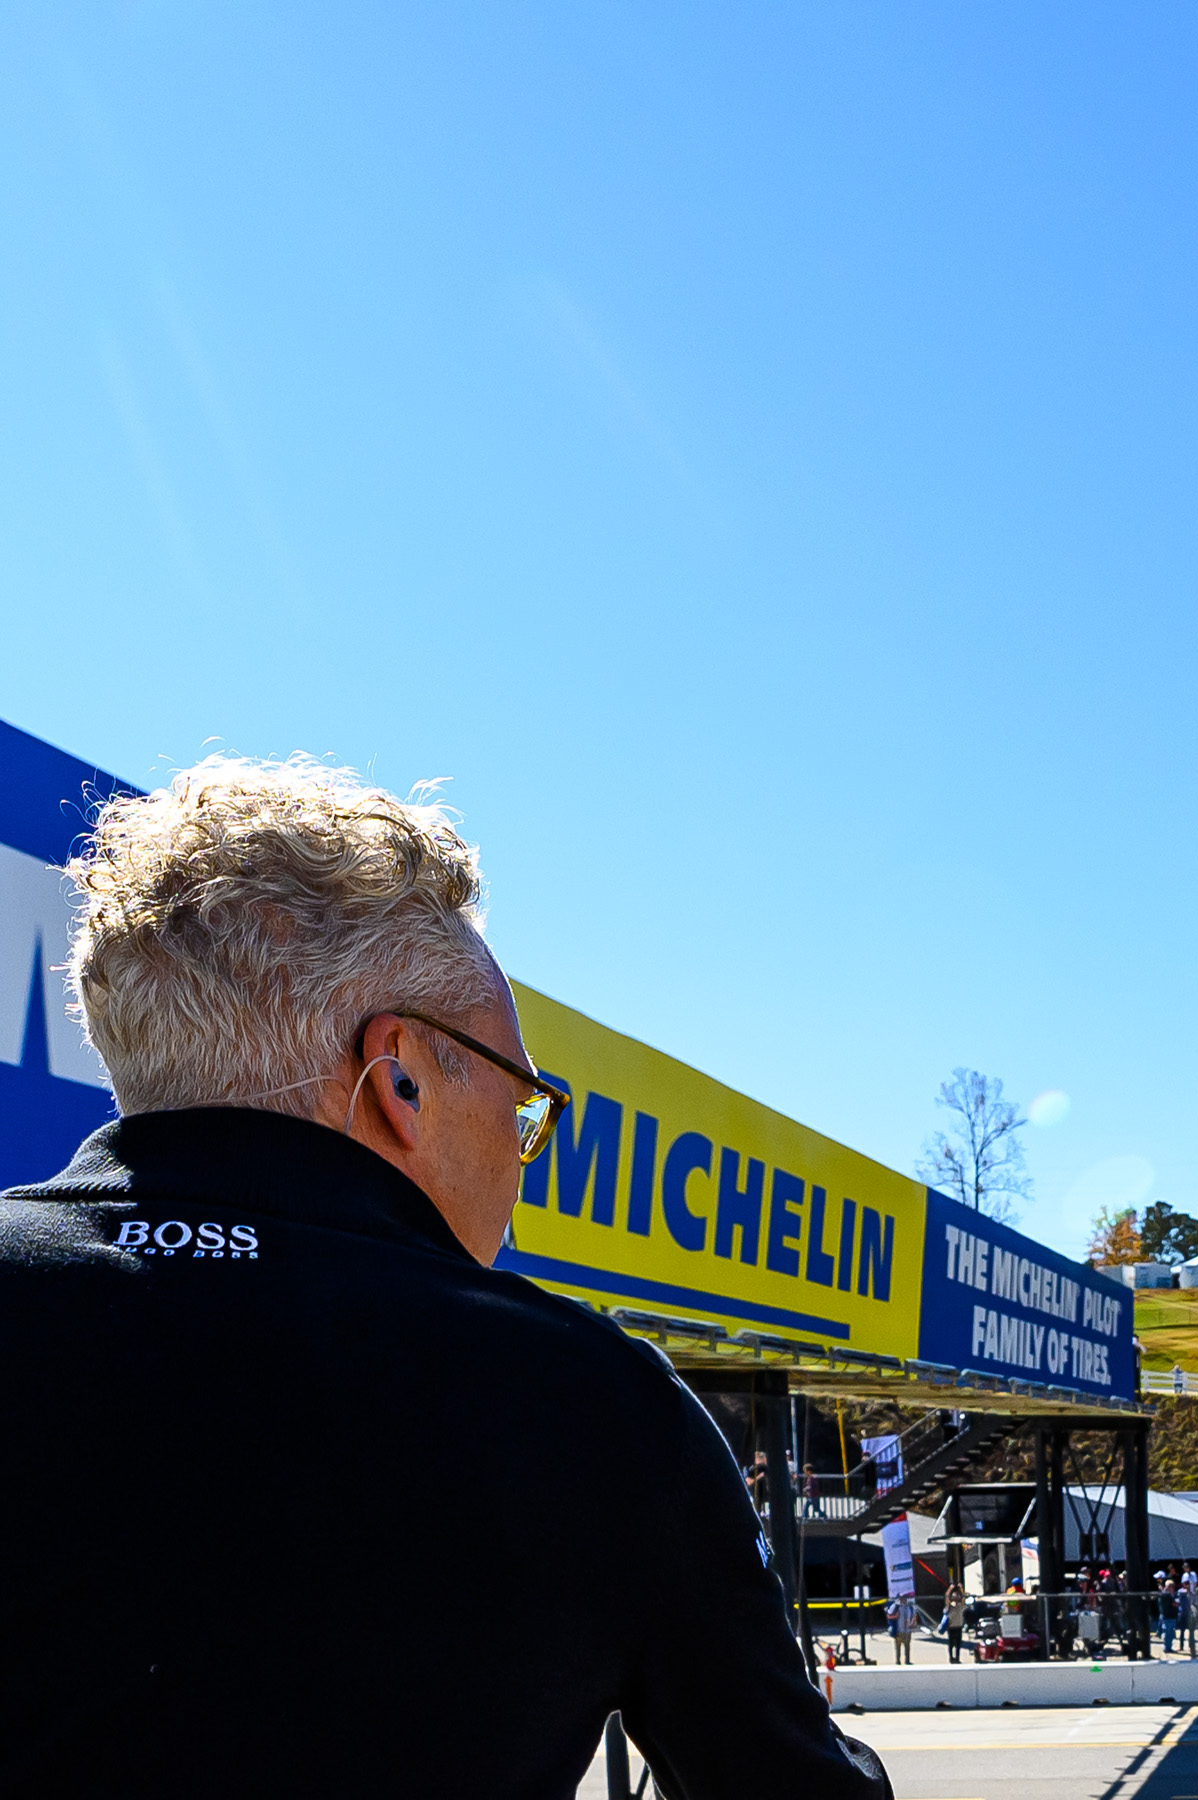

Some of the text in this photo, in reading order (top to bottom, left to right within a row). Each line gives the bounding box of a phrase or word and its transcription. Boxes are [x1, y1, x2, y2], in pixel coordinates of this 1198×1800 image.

[521, 1068, 895, 1302] MICHELIN
[113, 1220, 259, 1251] BOSS
[945, 1223, 1121, 1338] THE MICHELIN PILOT
[971, 1304, 1112, 1385] FAMILY OF TIRES.
